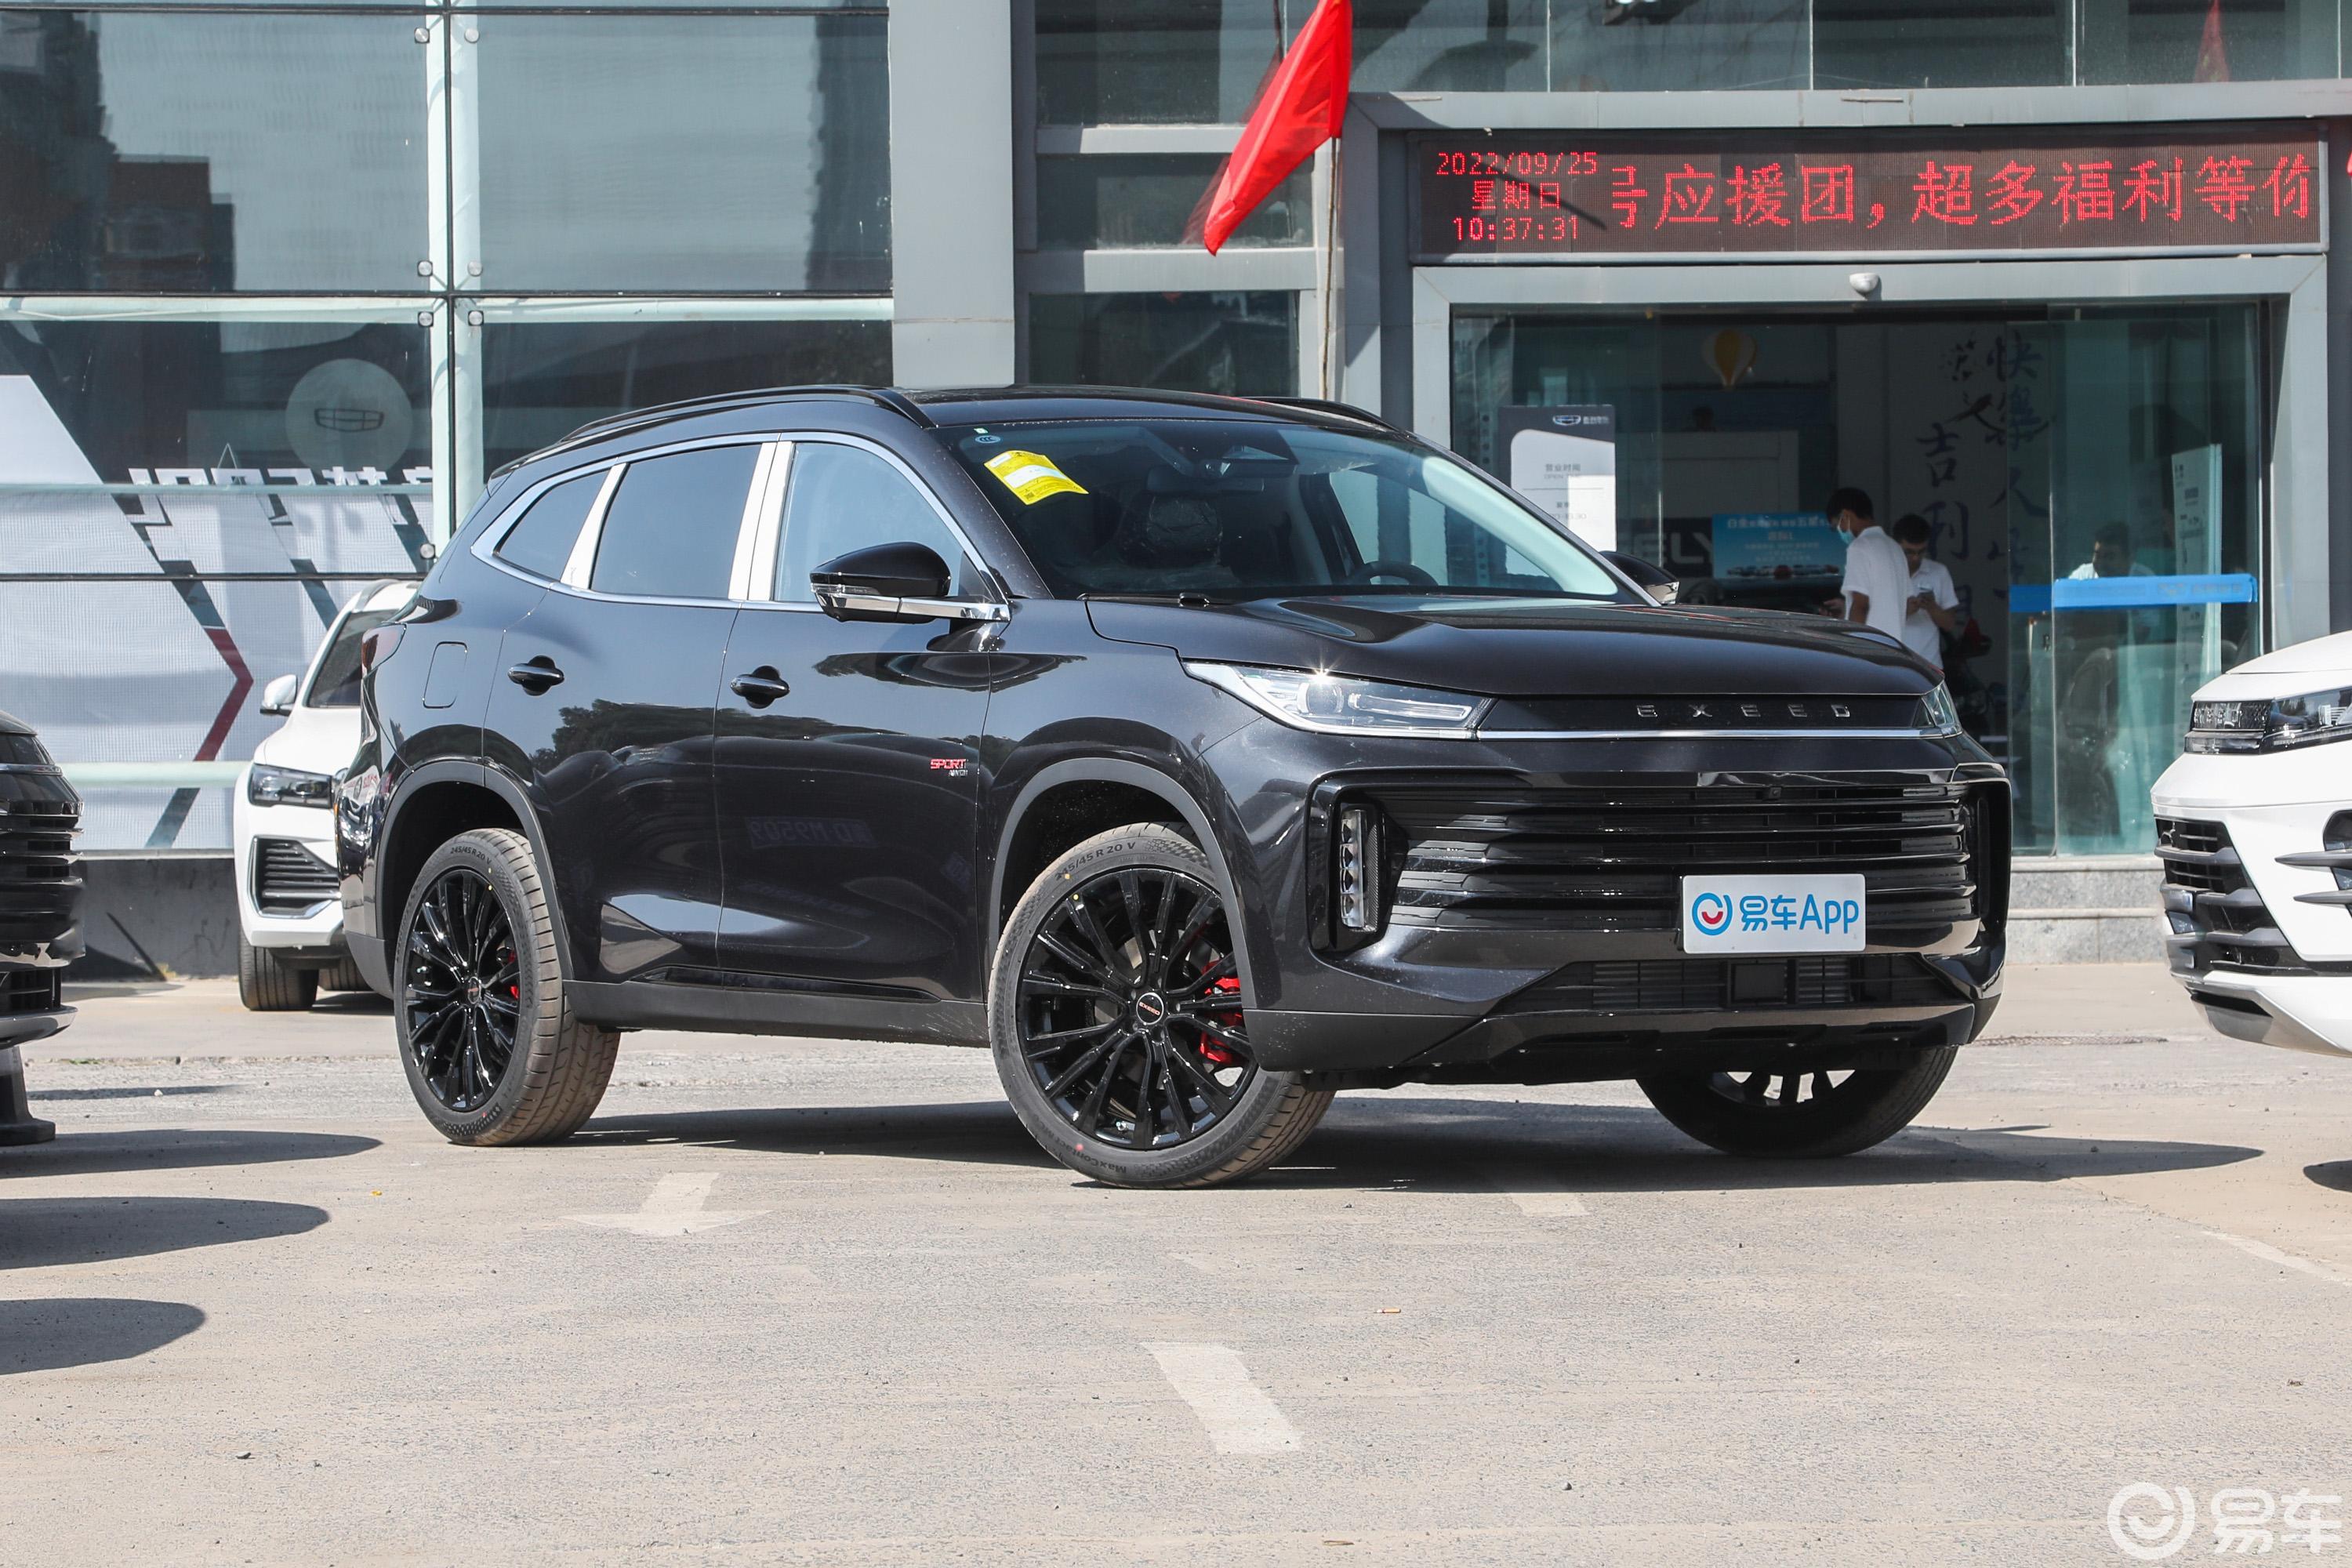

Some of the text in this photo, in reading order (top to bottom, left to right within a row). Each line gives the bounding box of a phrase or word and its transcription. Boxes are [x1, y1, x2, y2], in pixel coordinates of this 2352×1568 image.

[1436, 151, 1599, 176] 2022/09/25
[1472, 180, 1561, 211] 星期日
[1453, 216, 1579, 241] 10:37:31
[1636, 704, 1850, 717] EXEED
[930, 758, 967, 770] SPORT
[1739, 892, 1860, 935] 易车App
[1138, 1001, 1160, 1016] EXEED
